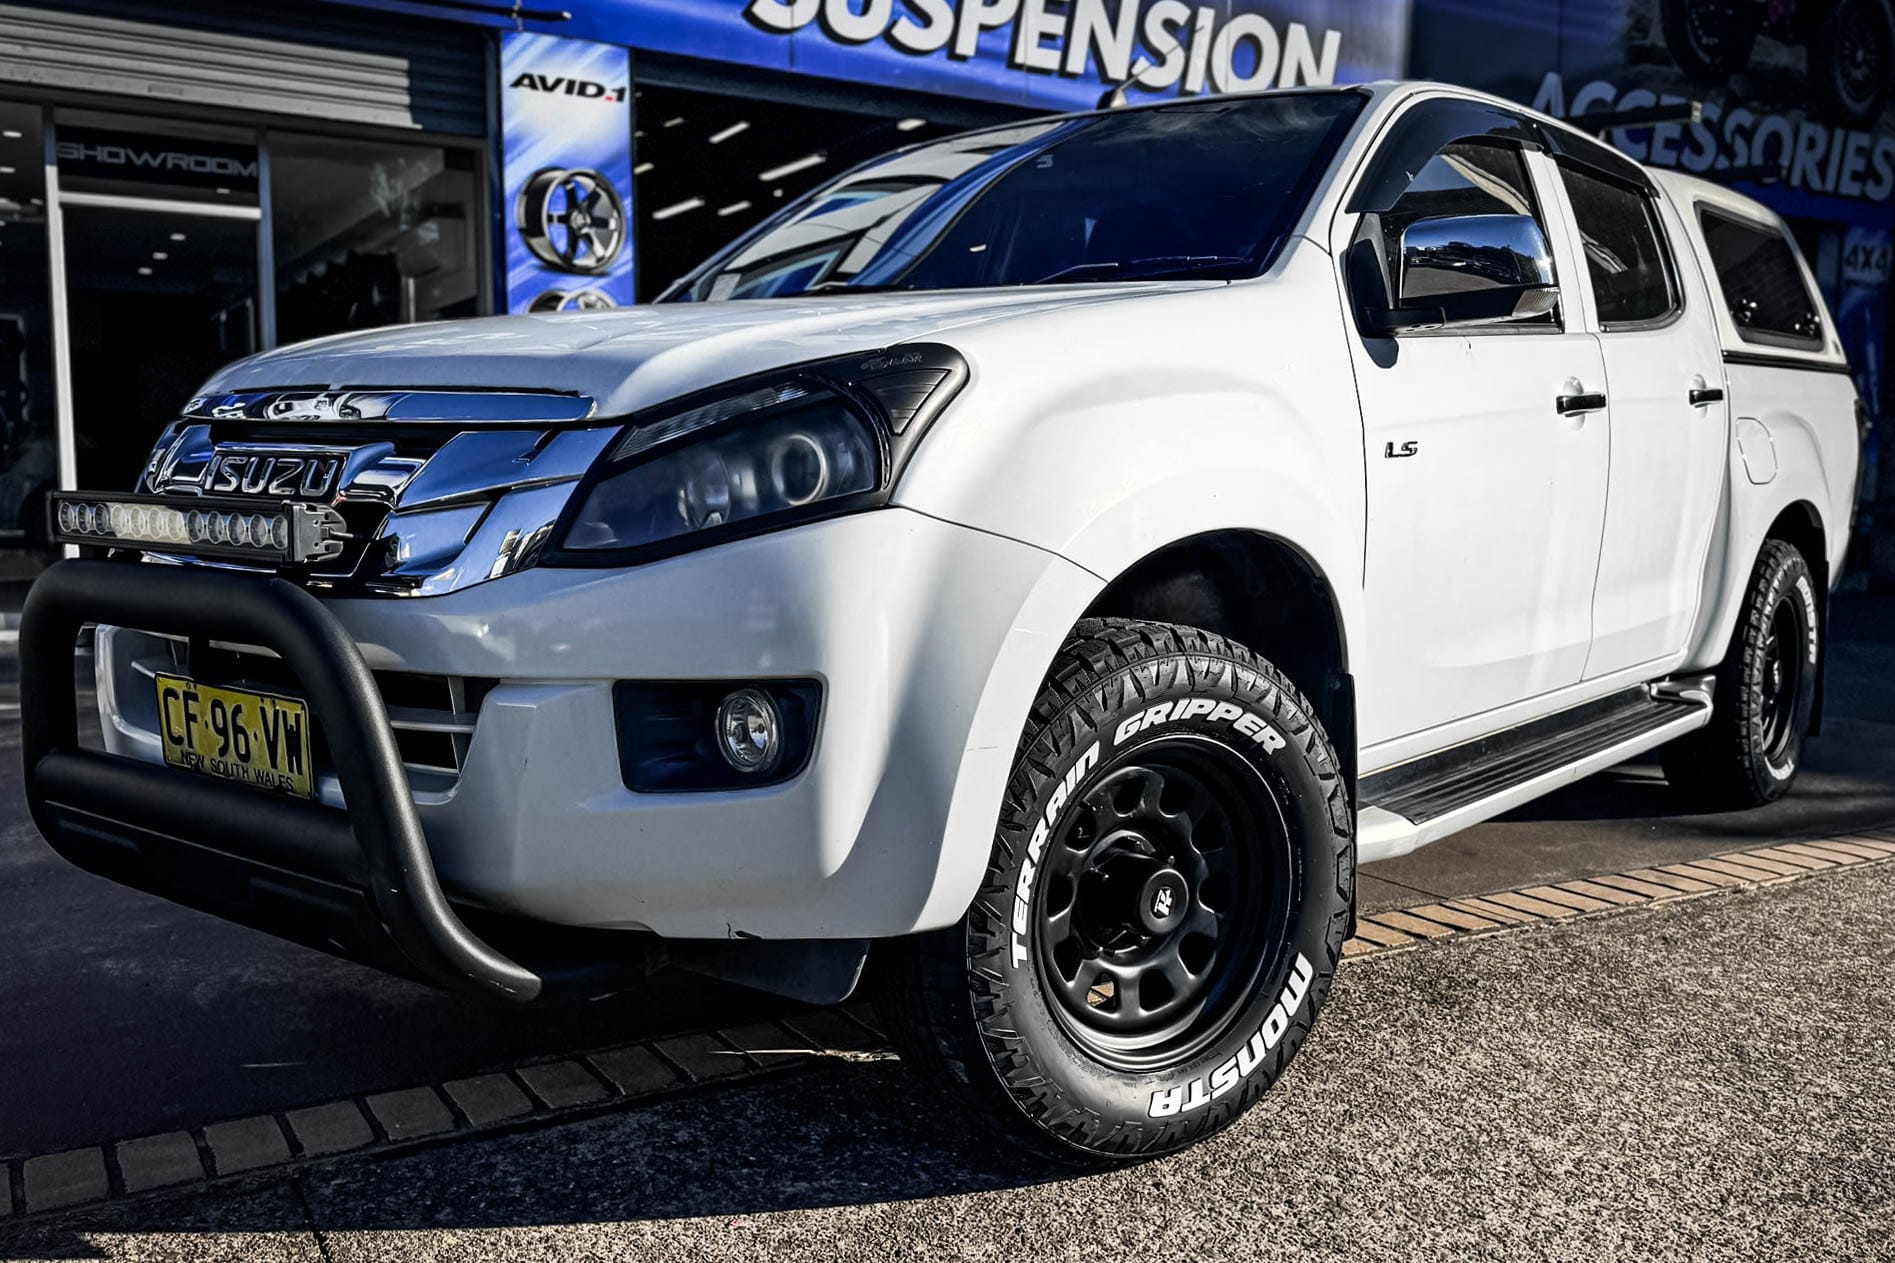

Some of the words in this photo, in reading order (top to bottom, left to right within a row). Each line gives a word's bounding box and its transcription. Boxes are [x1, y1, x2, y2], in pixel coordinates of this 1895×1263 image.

[509, 72, 627, 103] AVID.1
[57, 141, 259, 177] SHOWROOM
[1384, 441, 1418, 458] LS
[204, 456, 338, 497] ISUZU
[1113, 699, 1286, 755] GRIPPER
[180, 750, 204, 770] NEW
[210, 758, 250, 780] SOUTH
[253, 767, 294, 792] WALES
